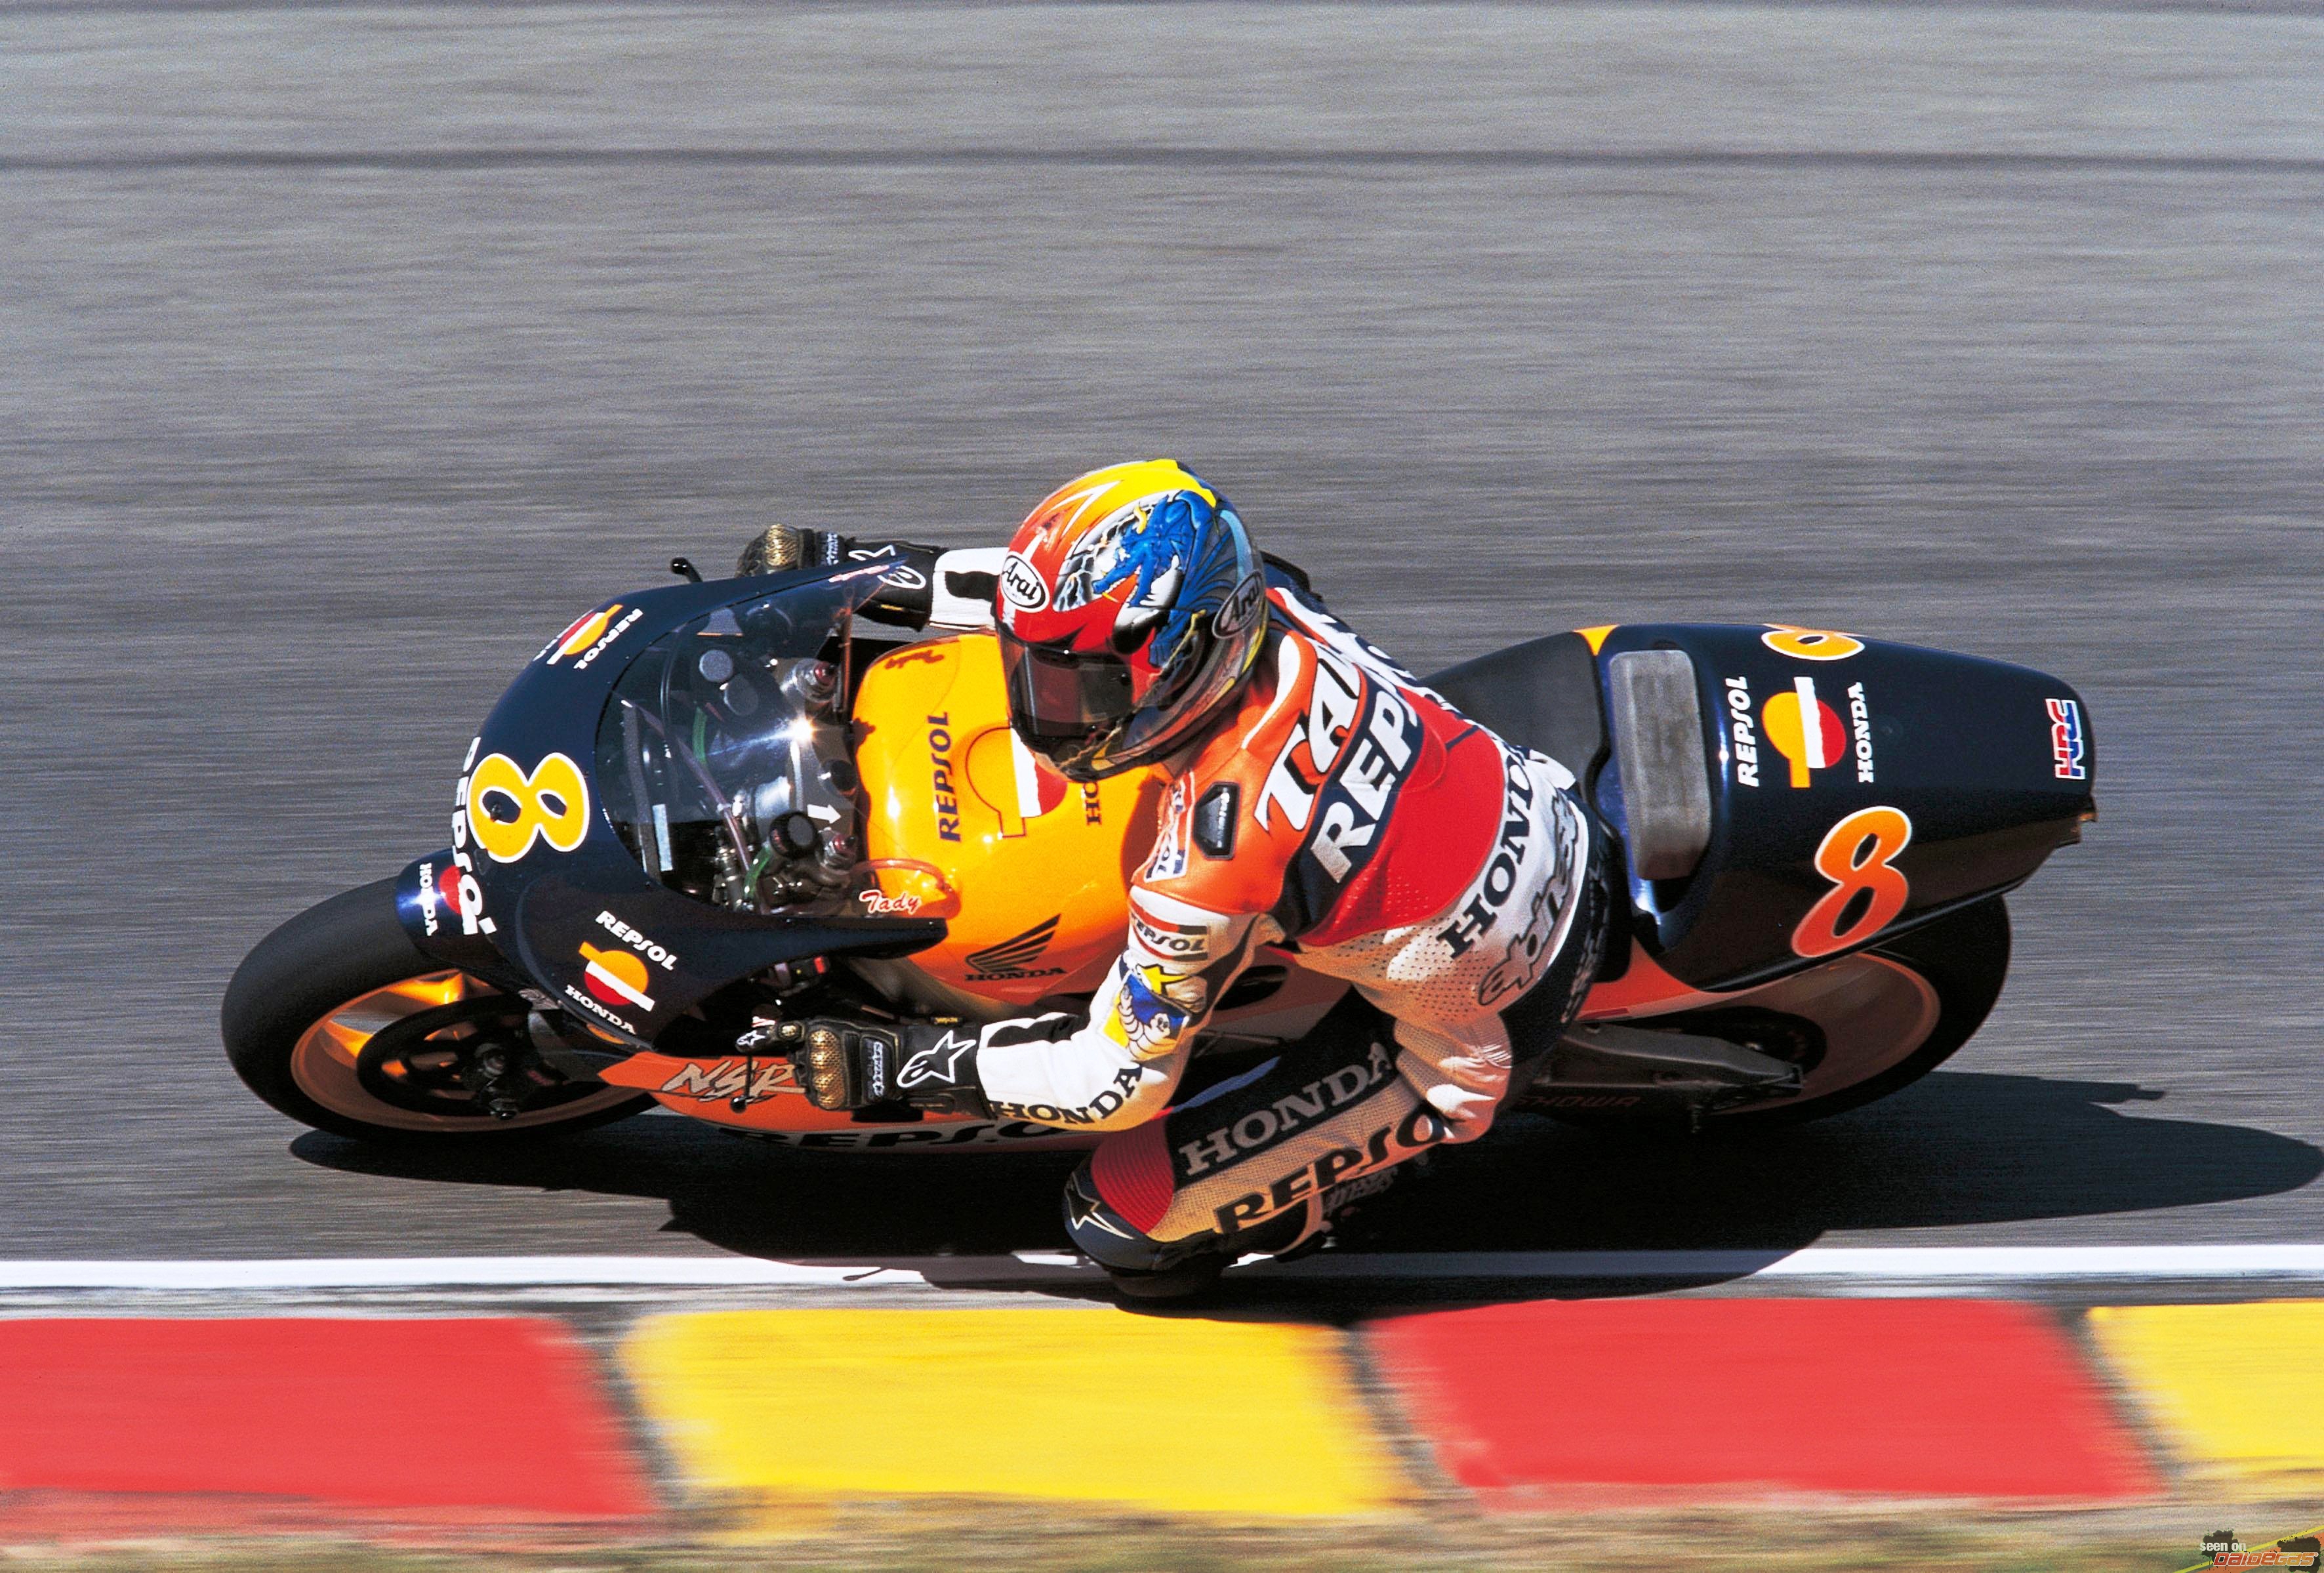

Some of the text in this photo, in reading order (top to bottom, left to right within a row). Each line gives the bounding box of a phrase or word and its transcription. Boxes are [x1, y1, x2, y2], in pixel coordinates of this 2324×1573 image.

[1002, 562, 1039, 600] Arai
[1725, 676, 1759, 786] REPSOL
[1847, 682, 1874, 783] HONDA
[2045, 698, 2086, 779] HRC
[466, 752, 590, 864] 8
[927, 712, 962, 843] REPSOL
[1311, 682, 1417, 883] REP
[452, 737, 497, 935] EPSO
[1436, 754, 1535, 959] HOND
[419, 863, 438, 936] HODA
[859, 889, 922, 914] Tady
[1791, 806, 1912, 958] 8
[596, 910, 678, 971] REPSOL
[1131, 912, 1205, 951] EPSOL
[565, 985, 637, 1035] HONDA
[966, 968, 1067, 981] HONDA
[661, 1060, 807, 1103] NSR
[989, 1064, 1143, 1123] HONDA
[1181, 1042, 1393, 1175] HONDA
[719, 1121, 1064, 1147] REPSO
[1215, 1114, 1444, 1235] REPSO
